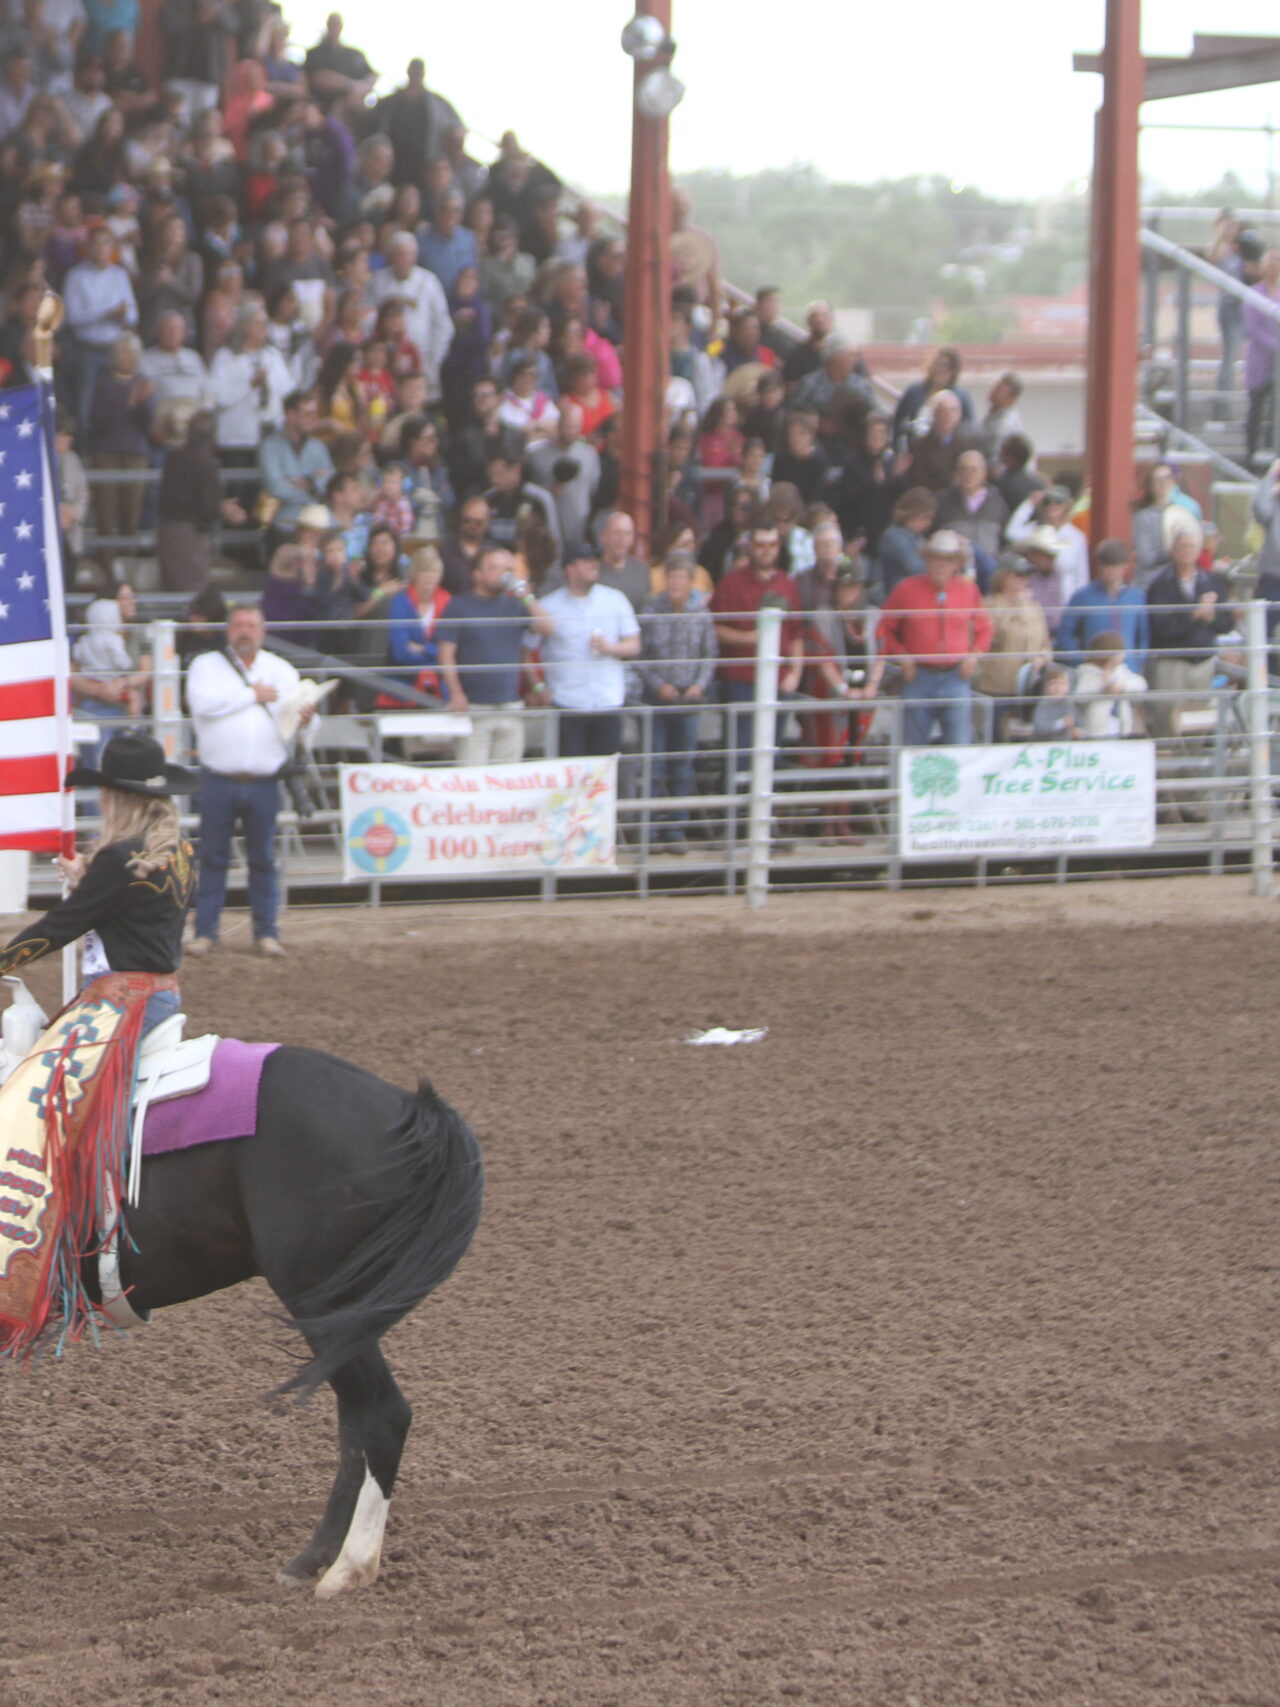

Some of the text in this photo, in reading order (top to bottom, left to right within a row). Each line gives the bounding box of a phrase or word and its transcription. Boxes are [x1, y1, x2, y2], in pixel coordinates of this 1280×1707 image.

[348, 770, 480, 794] Coca-Cola
[486, 771, 558, 791] Santa
[981, 771, 1136, 794] Tree Service
[411, 802, 538, 827] Celebrates
[427, 836, 544, 860] 100 Years
